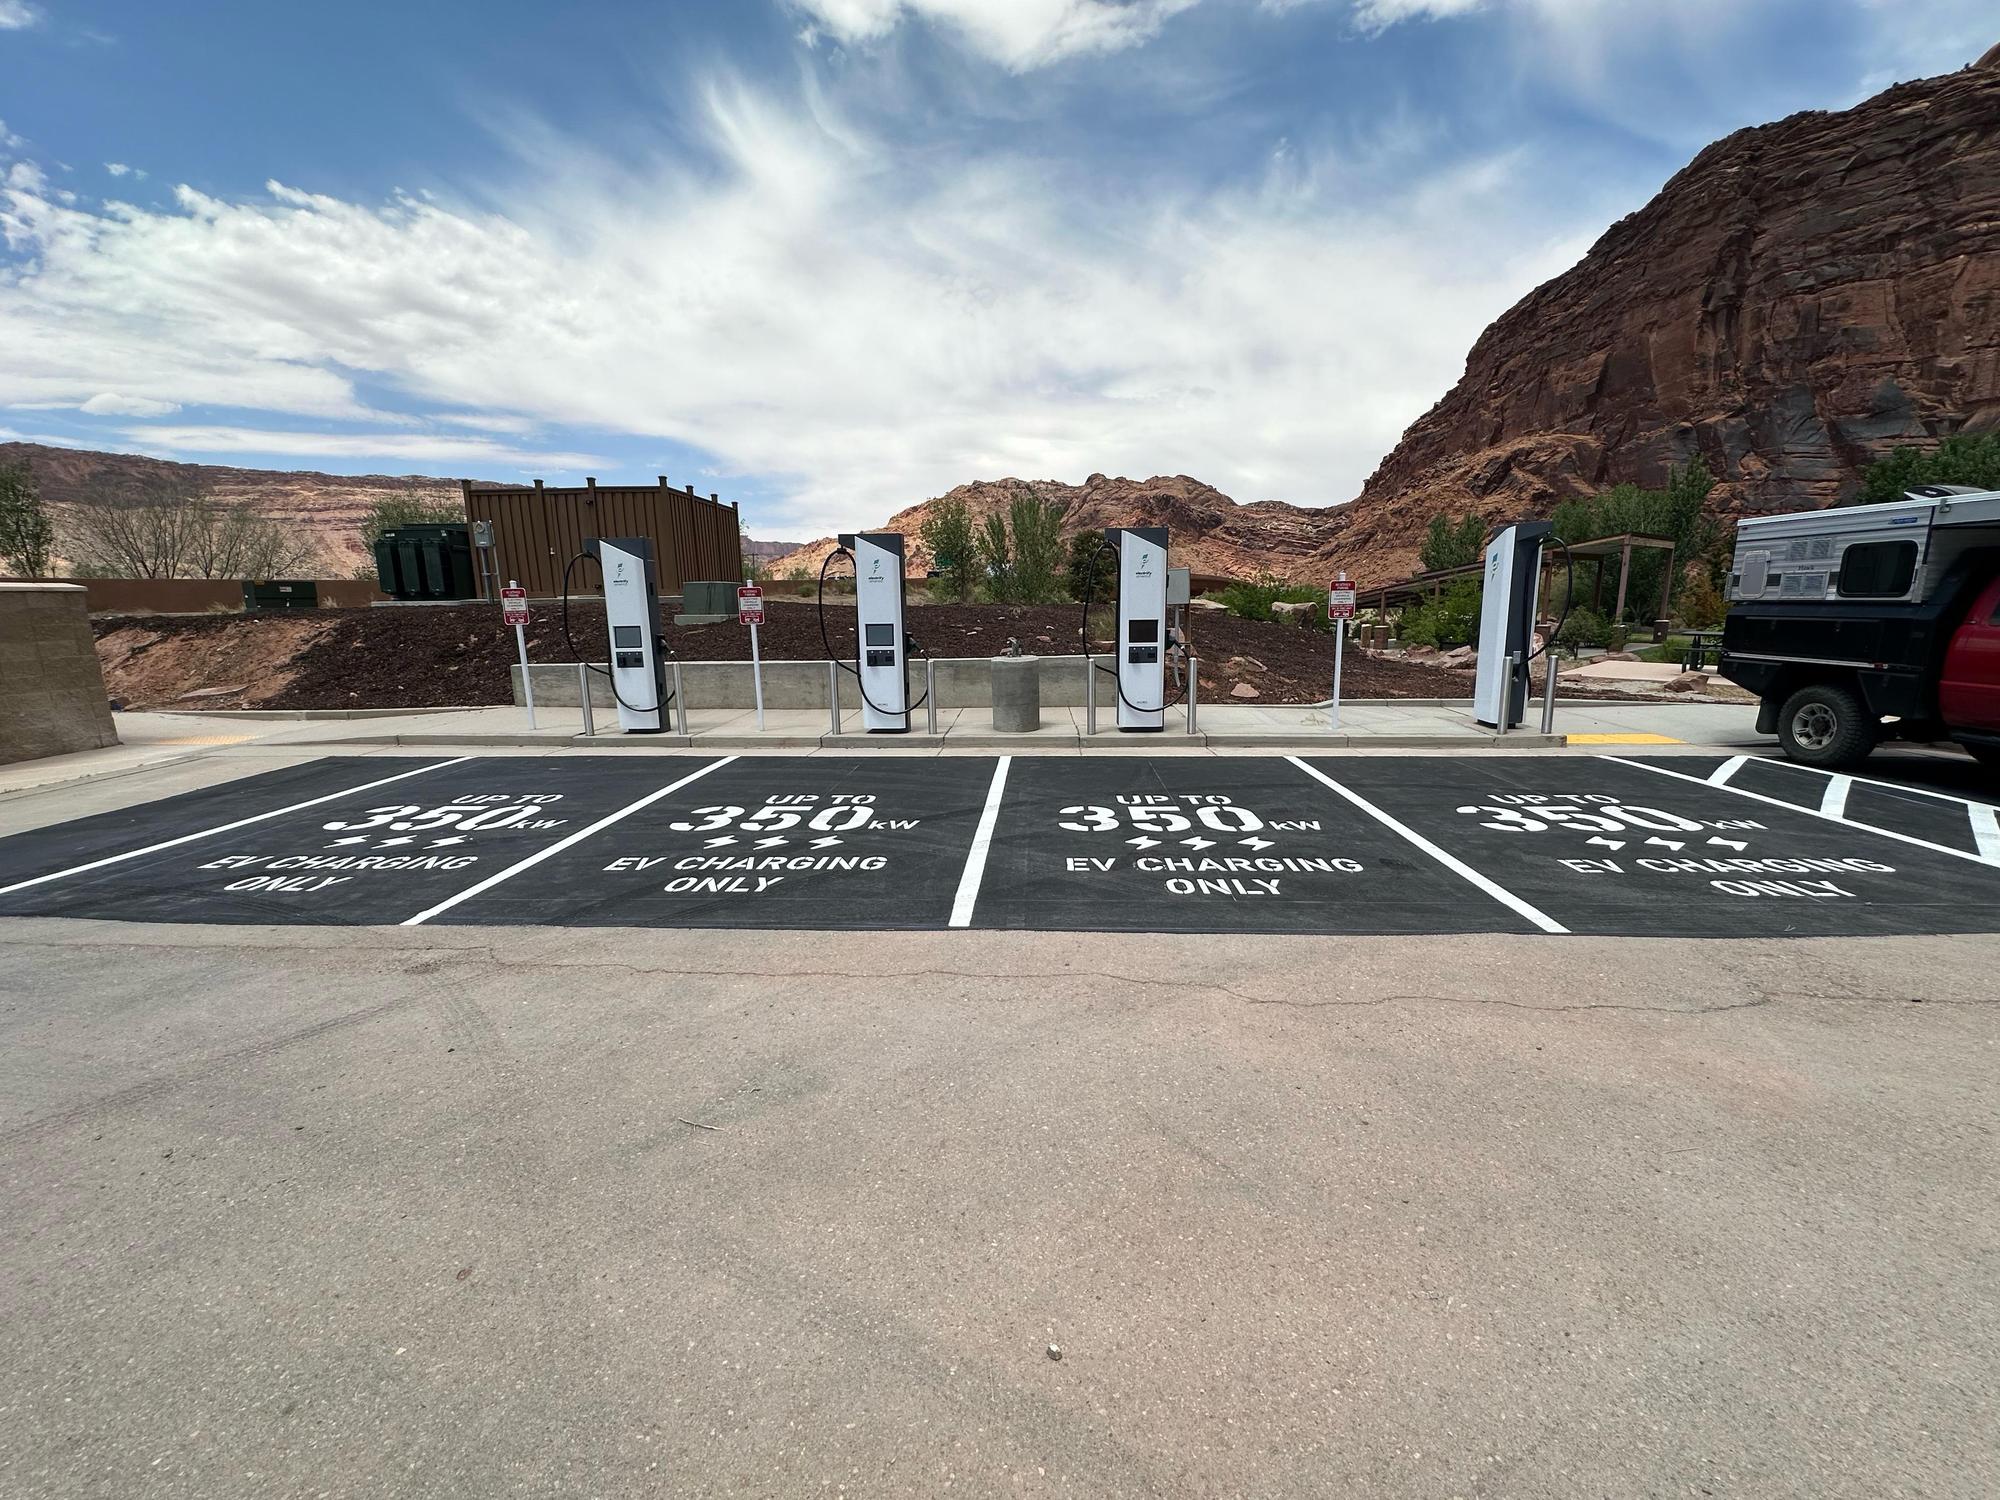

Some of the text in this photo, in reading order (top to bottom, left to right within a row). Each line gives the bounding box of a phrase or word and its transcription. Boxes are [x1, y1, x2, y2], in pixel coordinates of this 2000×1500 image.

[452, 794, 564, 804] UP TO
[765, 795, 877, 805] UP TO
[1115, 795, 1232, 805] UP TO
[1487, 795, 1621, 804] UP TO
[323, 805, 542, 831] 350
[670, 806, 874, 832] 350
[1058, 806, 1264, 832] 350
[1456, 806, 1704, 832] 350
[197, 856, 478, 870] EV CHARGING
[602, 857, 888, 871] EV CHARGING
[1066, 858, 1364, 873] EV CHARGING
[1556, 859, 1896, 873] EV CHARGING
[224, 876, 354, 892] ONLY
[664, 877, 785, 892] ONLY
[1165, 879, 1281, 895] ONLY
[1710, 881, 1856, 897] ONLY
